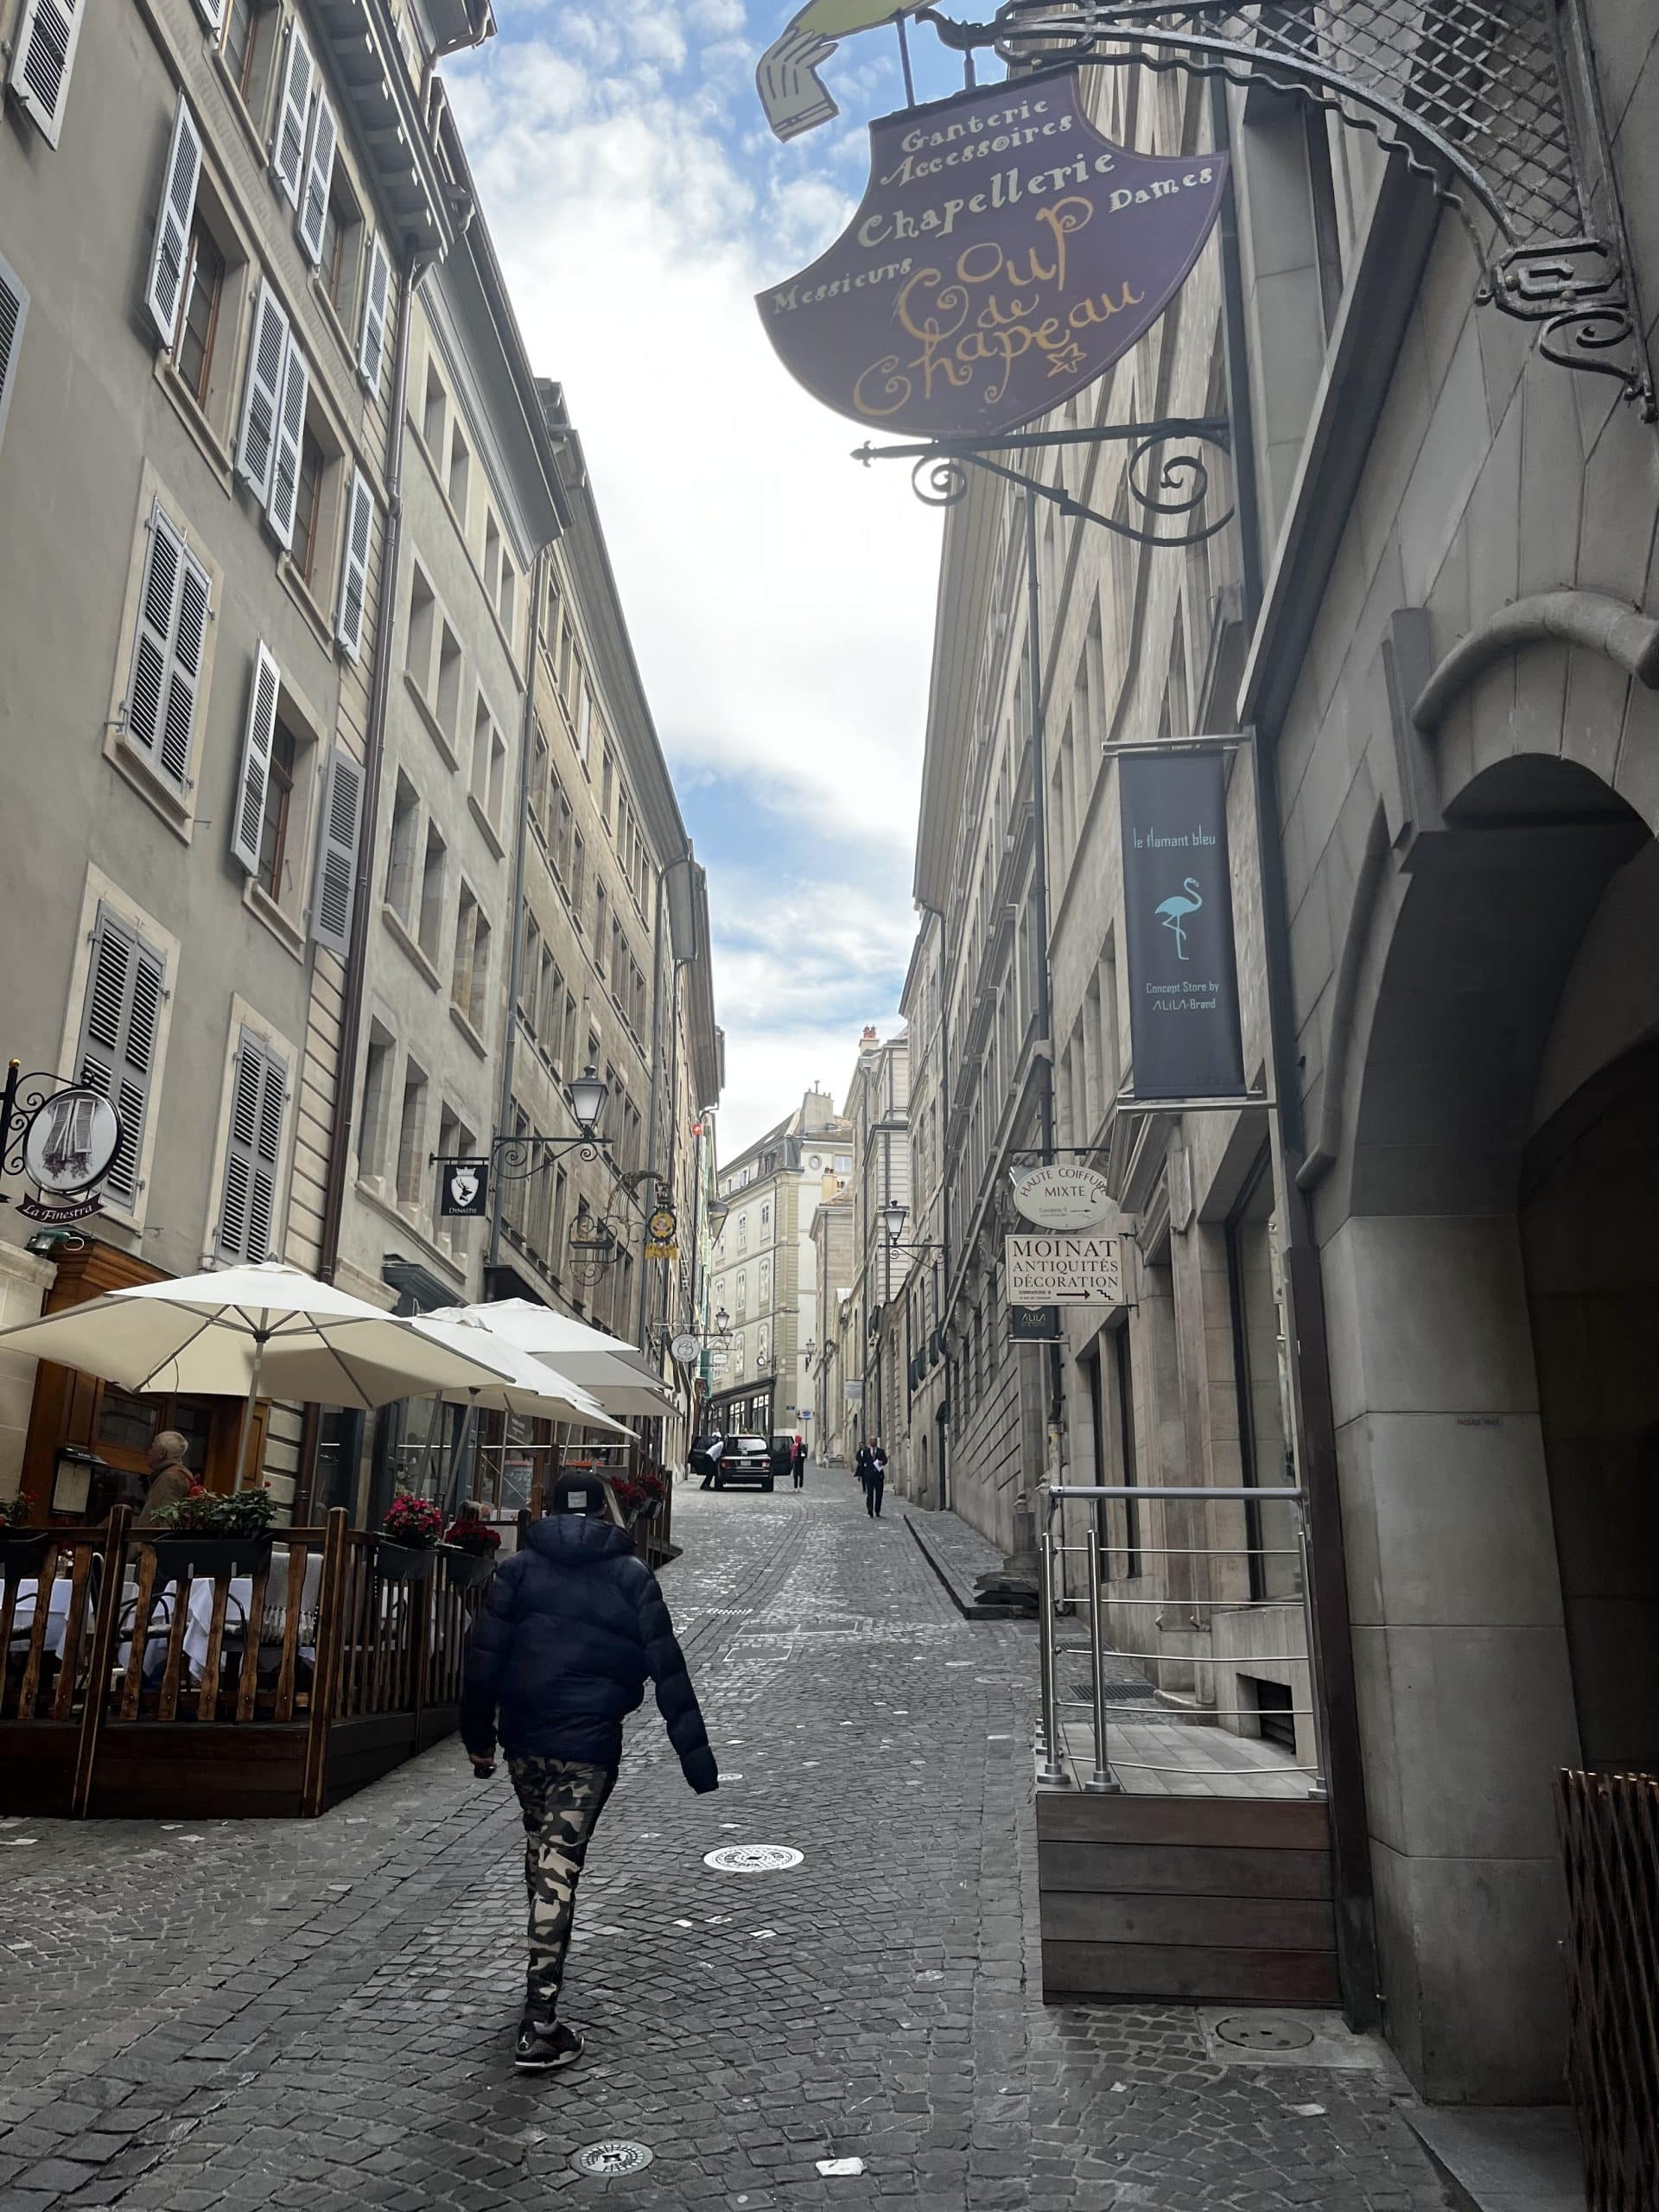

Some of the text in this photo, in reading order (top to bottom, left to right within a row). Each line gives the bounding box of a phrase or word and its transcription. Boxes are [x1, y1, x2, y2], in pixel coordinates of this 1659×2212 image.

[901, 99, 1048, 152] Ganterie
[880, 115, 1072, 188] Accessoires
[858, 153, 1116, 247] Chapellerie
[1109, 168, 1213, 214] Dames
[895, 196, 1094, 340] Coup
[772, 258, 913, 314] Messieurs
[976, 294, 1039, 329] de
[853, 281, 1145, 416] Chapeau
[1134, 824, 1216, 849] le flamant bleu
[1146, 981, 1219, 995] Concept Store by
[1020, 1170, 1052, 1197] HAUTE
[1044, 1185, 1085, 1197] MIXTE
[22, 1204, 93, 1221] La Finestra
[1014, 1240, 1117, 1257] MOINAT
[1013, 1259, 1119, 1275] ANTIQUITÉS
[1014, 1274, 1119, 1287] DÉCORATION
